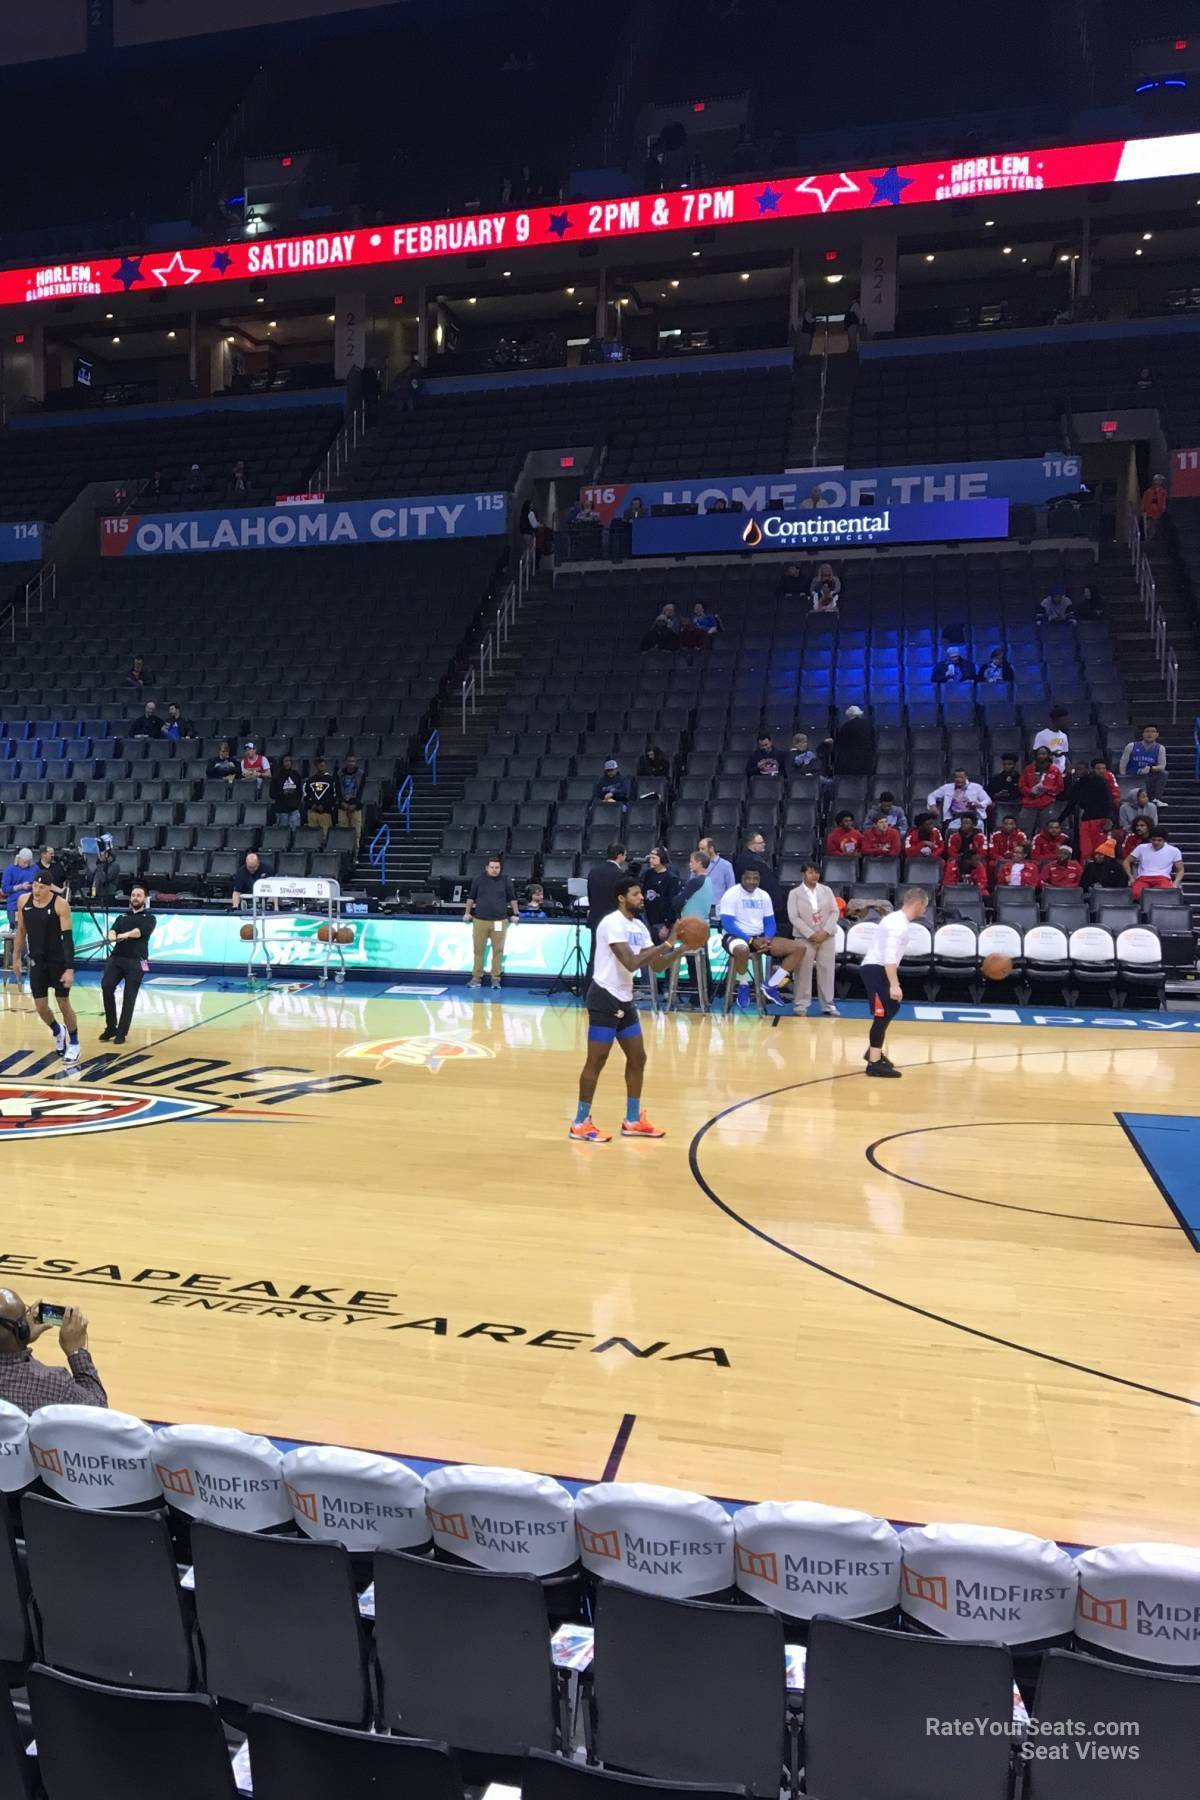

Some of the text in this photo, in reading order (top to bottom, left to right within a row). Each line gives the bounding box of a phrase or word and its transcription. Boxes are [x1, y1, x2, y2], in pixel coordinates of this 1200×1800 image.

[952, 156, 1029, 182] HARLEM
[935, 174, 1044, 200] GLOBETROTTERS
[248, 190, 734, 272] SATURDAY FEBRUARY 9 2PM & 7PM
[36, 265, 91, 287] HARLEM
[26, 282, 101, 302] GLOBETROTTERS
[345, 311, 355, 357] 222
[1042, 460, 1078, 477] 116
[585, 488, 616, 504] 116
[891, 473, 989, 504] THE
[475, 495, 504, 512] 115
[13, 524, 39, 539] 114
[104, 518, 129, 534] 115
[136, 504, 465, 552] OKLAHOMA CITY
[764, 511, 890, 537] Continental
[781, 533, 874, 544] RESOURCES
[1032, 1015, 1200, 1029] pay
[150, 1294, 376, 1326] ENERGY
[387, 1316, 732, 1368] ARENA
[66, 1468, 115, 1487] BANK
[199, 1487, 246, 1511] BANK
[324, 1512, 378, 1532] BANK
[474, 1530, 531, 1554] BANK
[627, 1550, 684, 1575] BANK
[785, 1574, 849, 1596] BANK
[956, 1600, 1023, 1622] BANK
